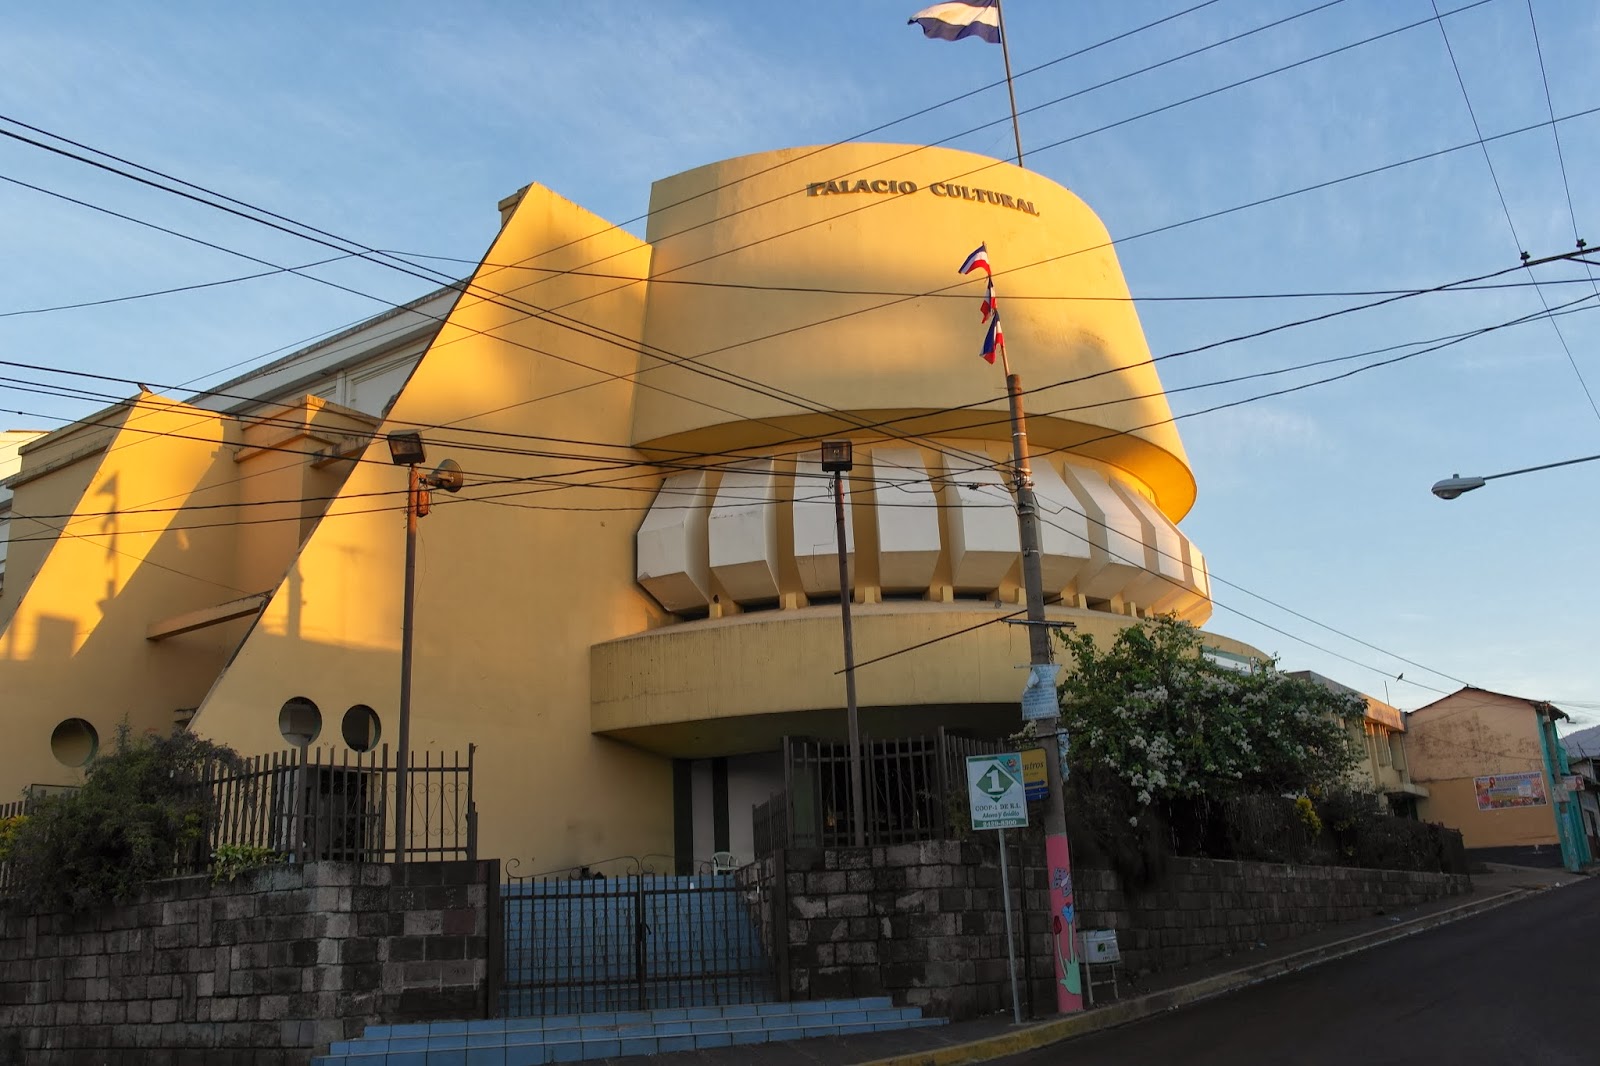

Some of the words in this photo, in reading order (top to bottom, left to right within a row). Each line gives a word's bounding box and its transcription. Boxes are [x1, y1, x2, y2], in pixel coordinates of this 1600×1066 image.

[806, 179, 918, 197] PALACIO
[929, 182, 1040, 216] CULTURAL
[986, 769, 1005, 793] 1
